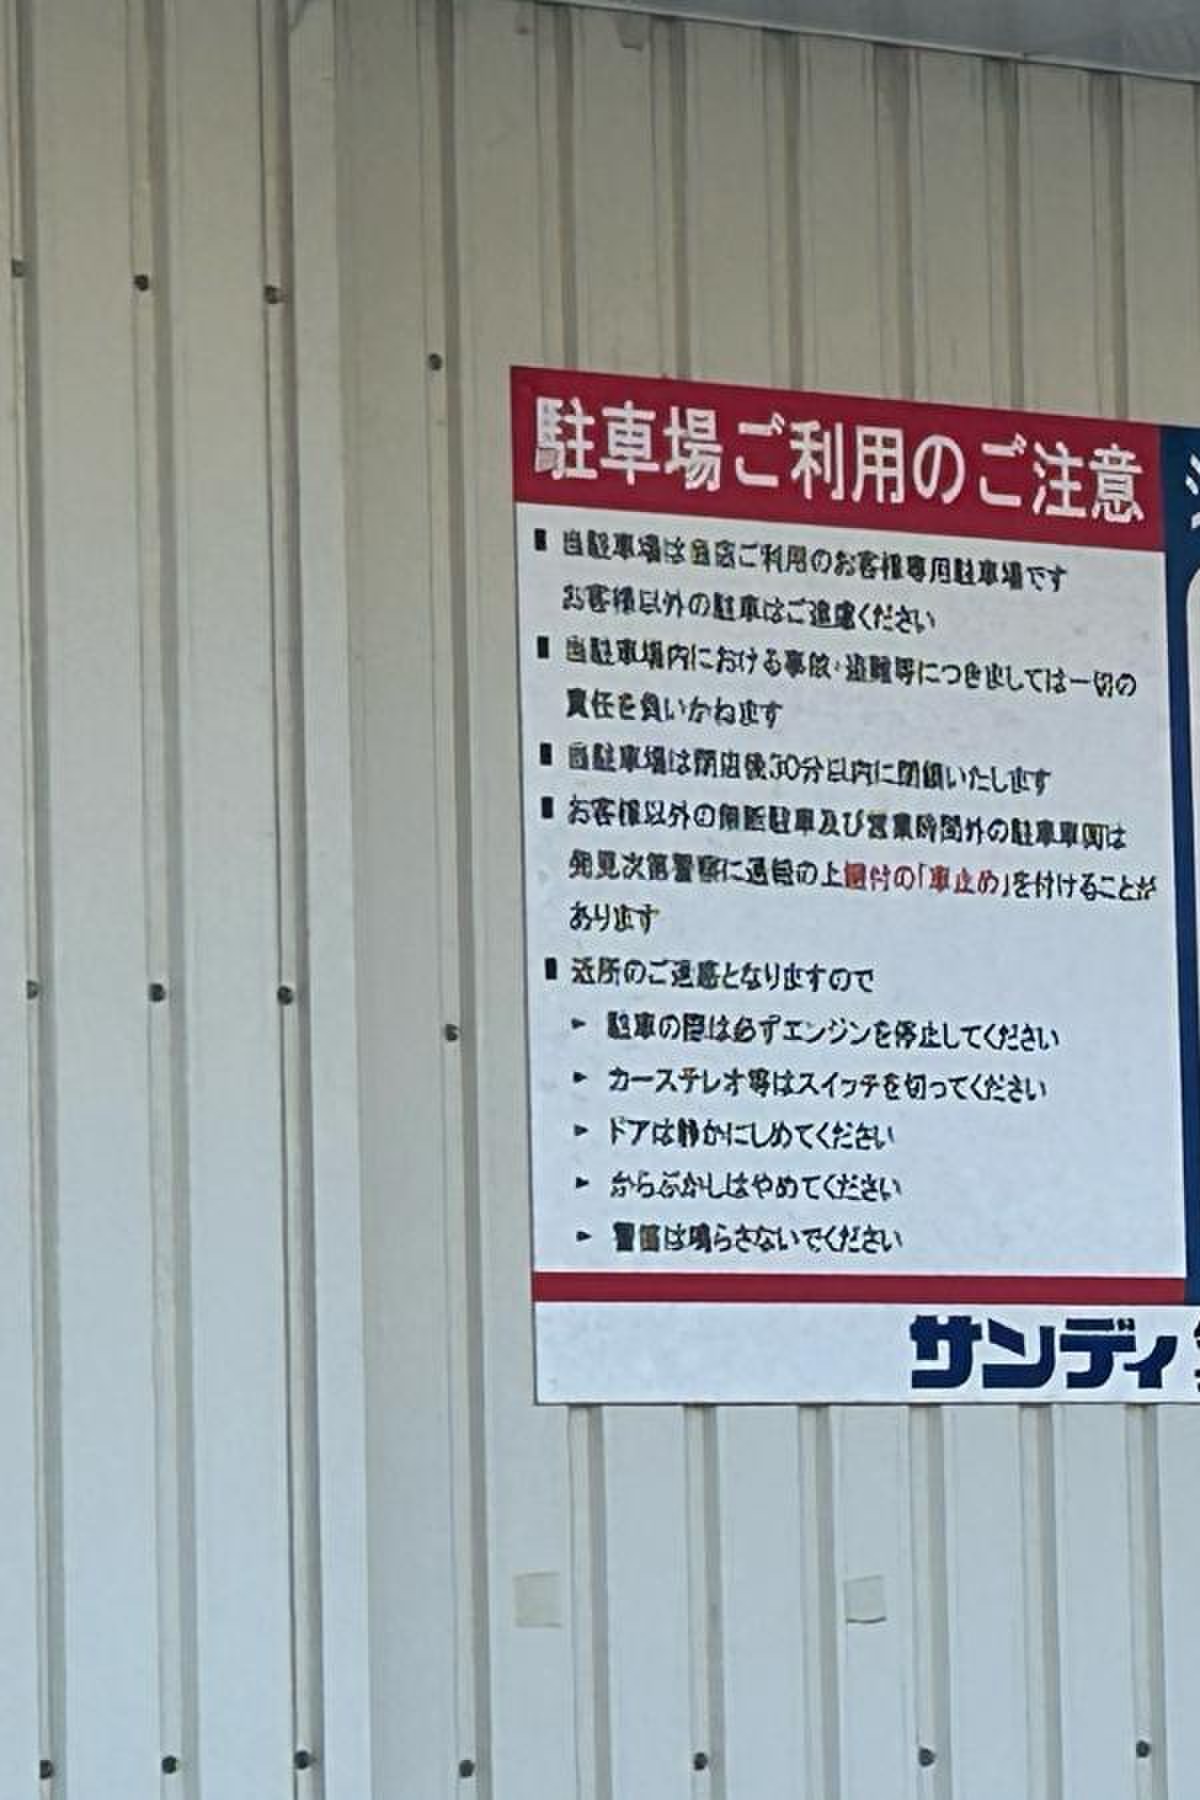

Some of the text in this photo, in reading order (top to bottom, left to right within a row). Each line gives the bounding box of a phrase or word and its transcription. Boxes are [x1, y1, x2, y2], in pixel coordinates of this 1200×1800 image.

[534, 396, 1145, 524] 駐車場ご利用のご注意
[569, 901, 660, 935] あります
[610, 1115, 896, 1151] ドアは静かにしめてください
